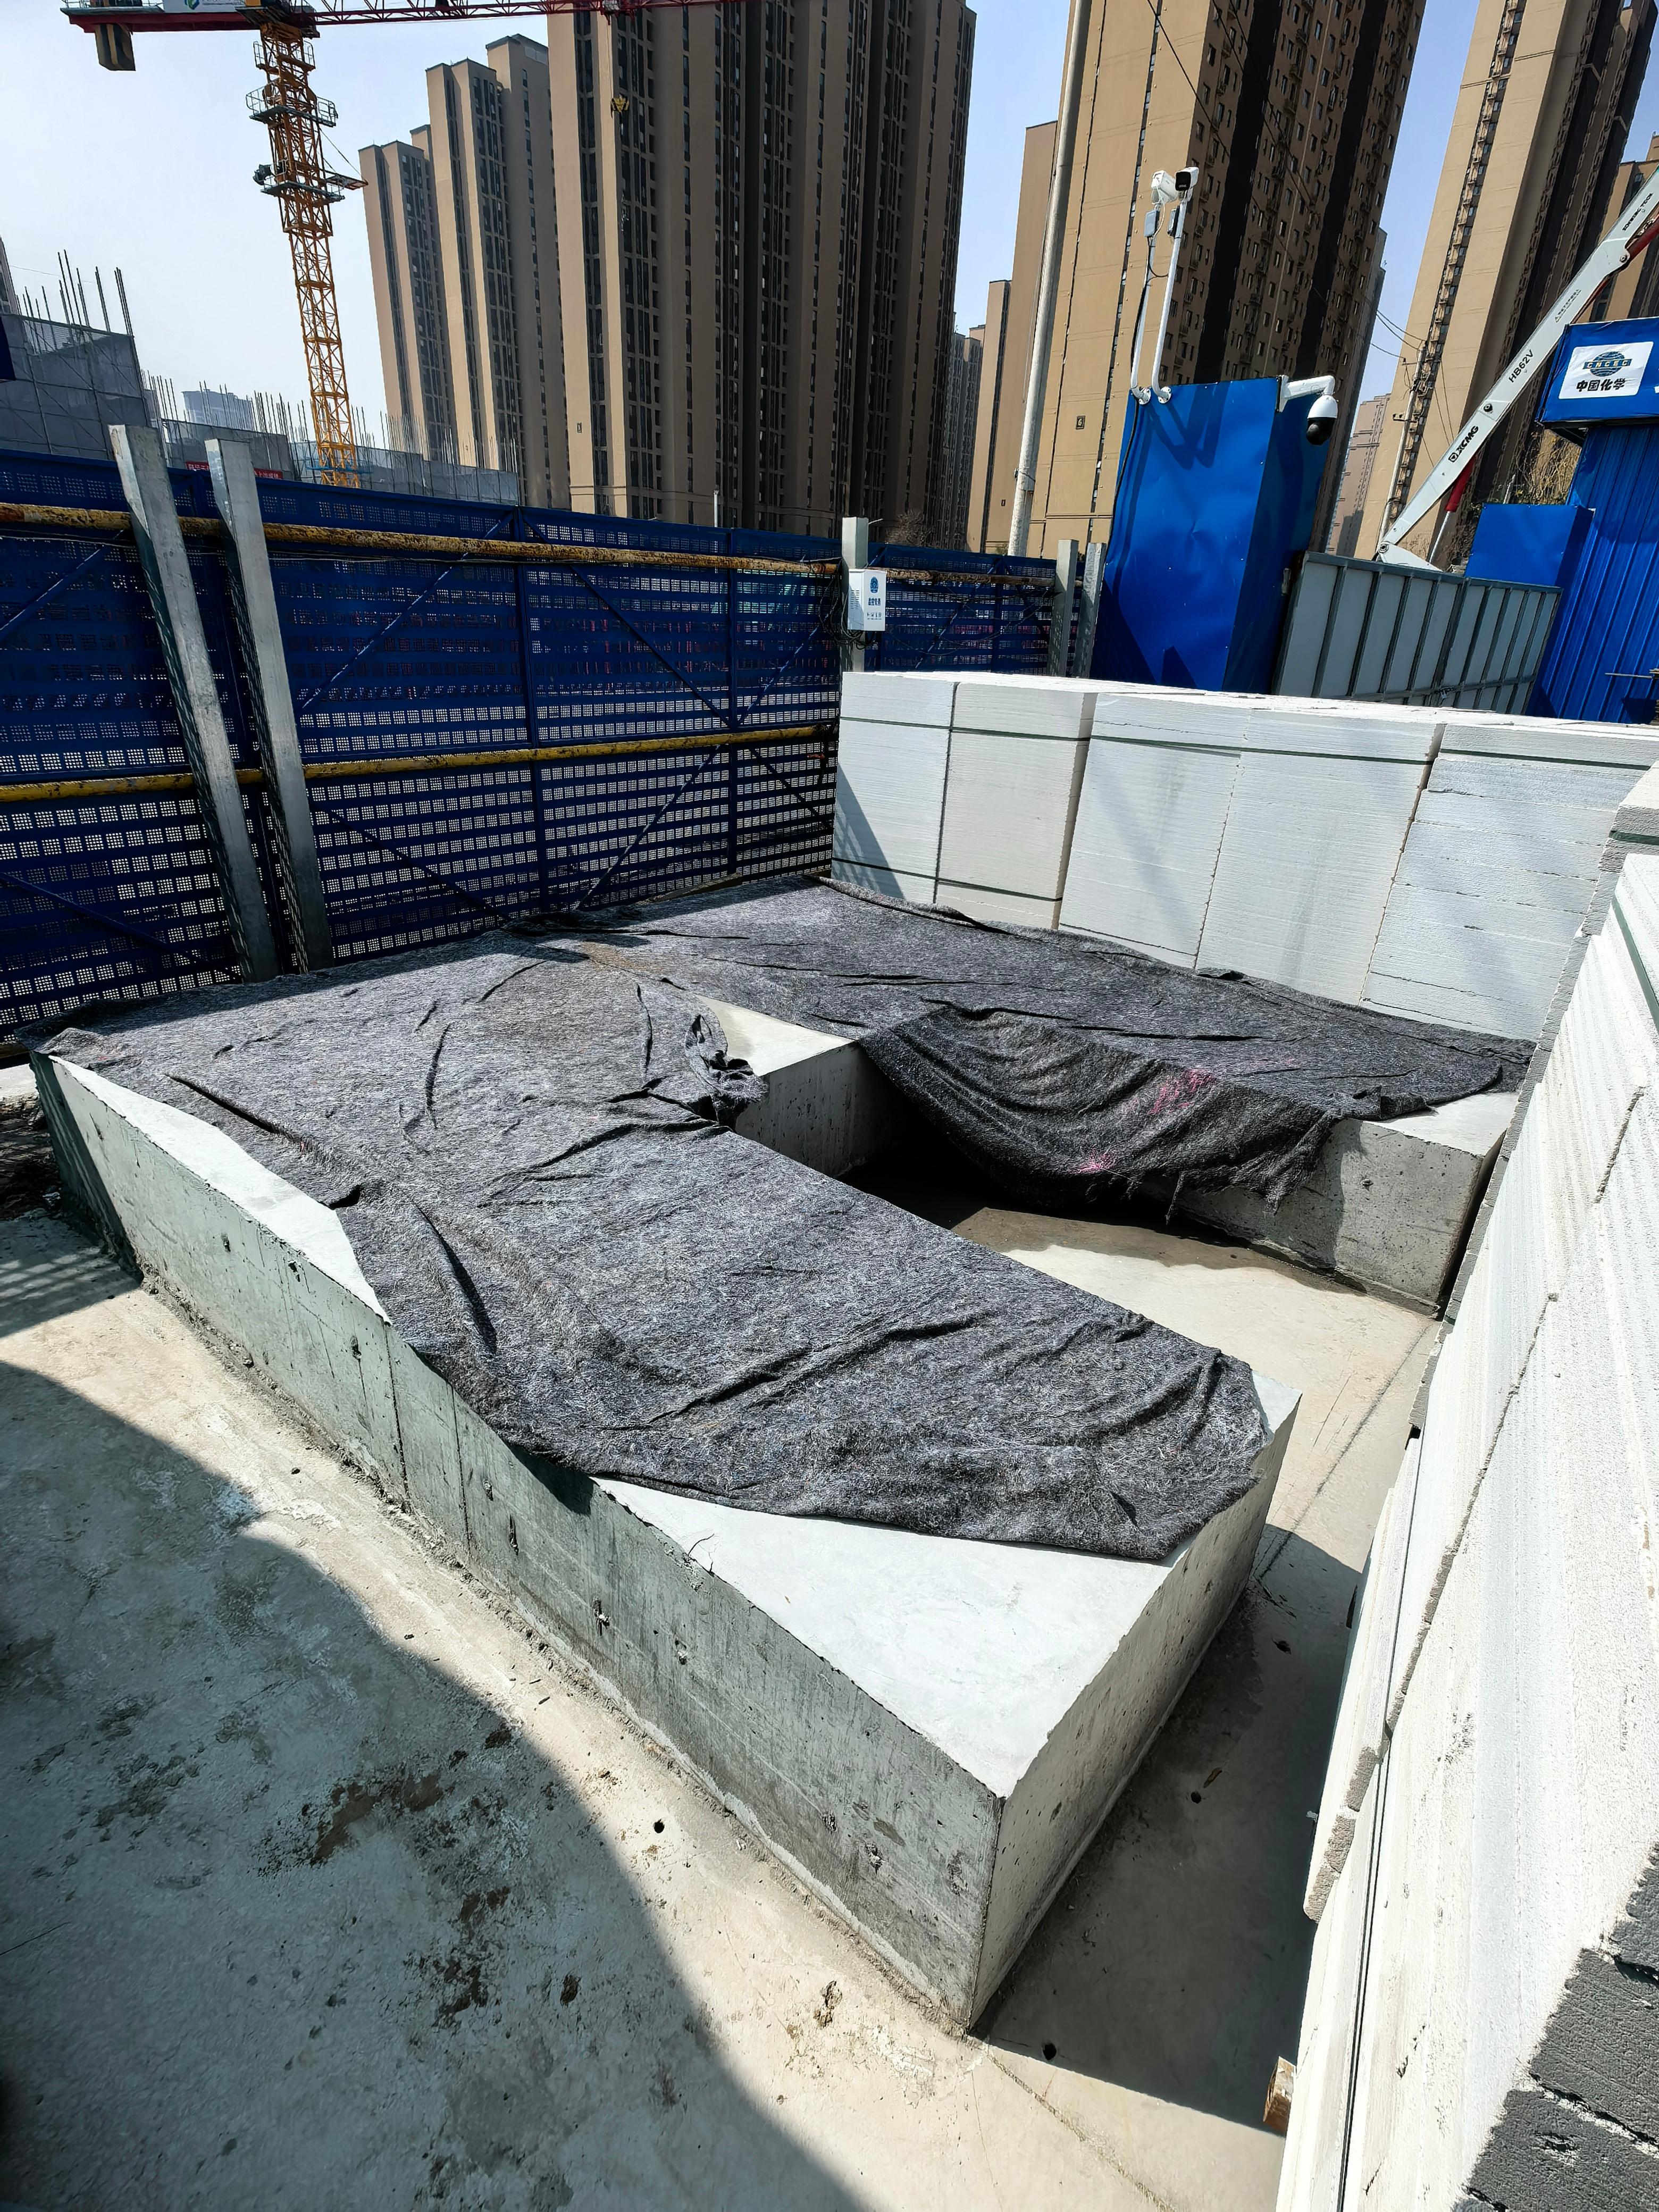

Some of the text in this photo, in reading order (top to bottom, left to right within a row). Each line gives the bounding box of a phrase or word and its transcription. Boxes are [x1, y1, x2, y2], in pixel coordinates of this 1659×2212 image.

[1509, 349, 1533, 383] HB62V
[1586, 359, 1629, 368] CNCEC
[1576, 378, 1626, 392] 中国化学
[1456, 425, 1479, 456] XCMG
